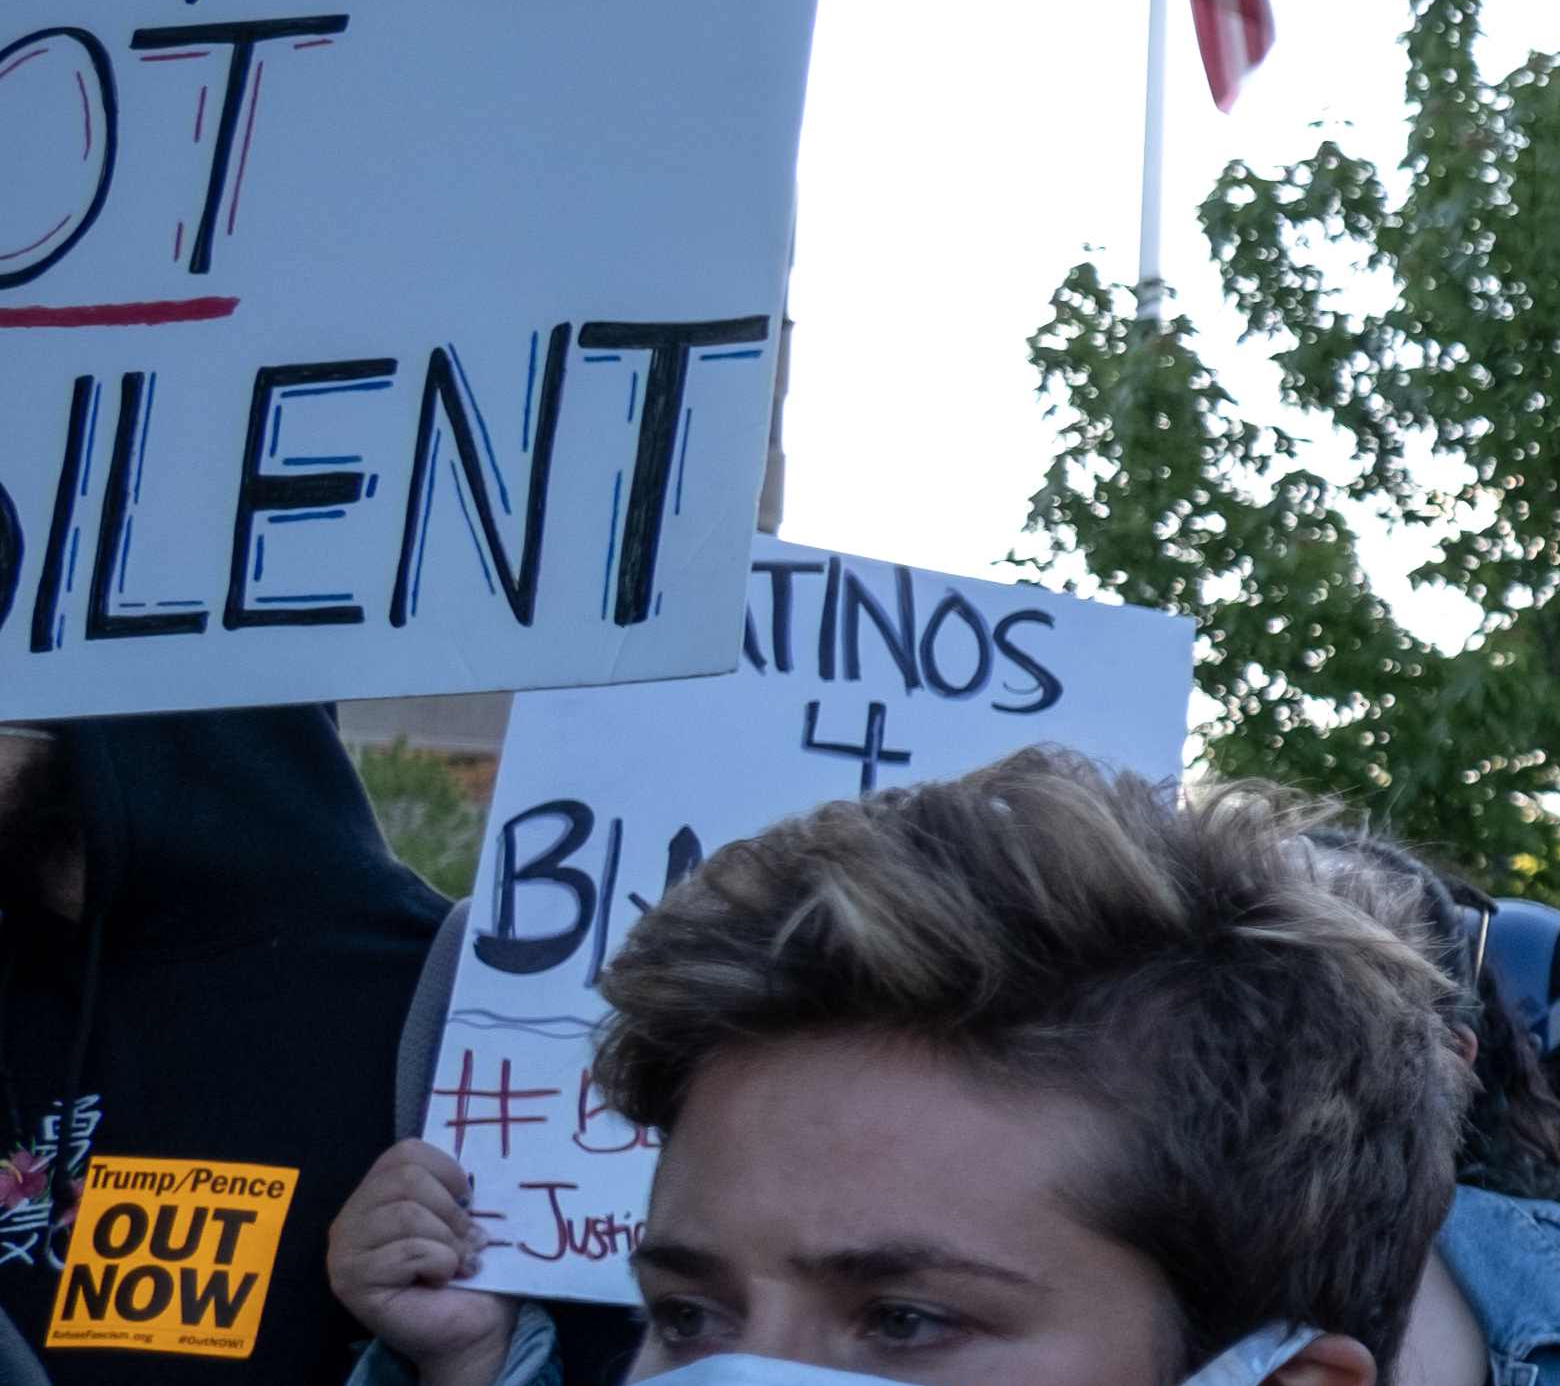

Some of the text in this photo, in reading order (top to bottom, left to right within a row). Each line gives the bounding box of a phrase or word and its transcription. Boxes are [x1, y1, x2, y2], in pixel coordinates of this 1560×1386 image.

[802, 701, 911, 793] 4
[90, 1163, 286, 1199] Trump/Pence
[92, 1201, 258, 1266] OUT
[61, 1263, 259, 1329] NOW
